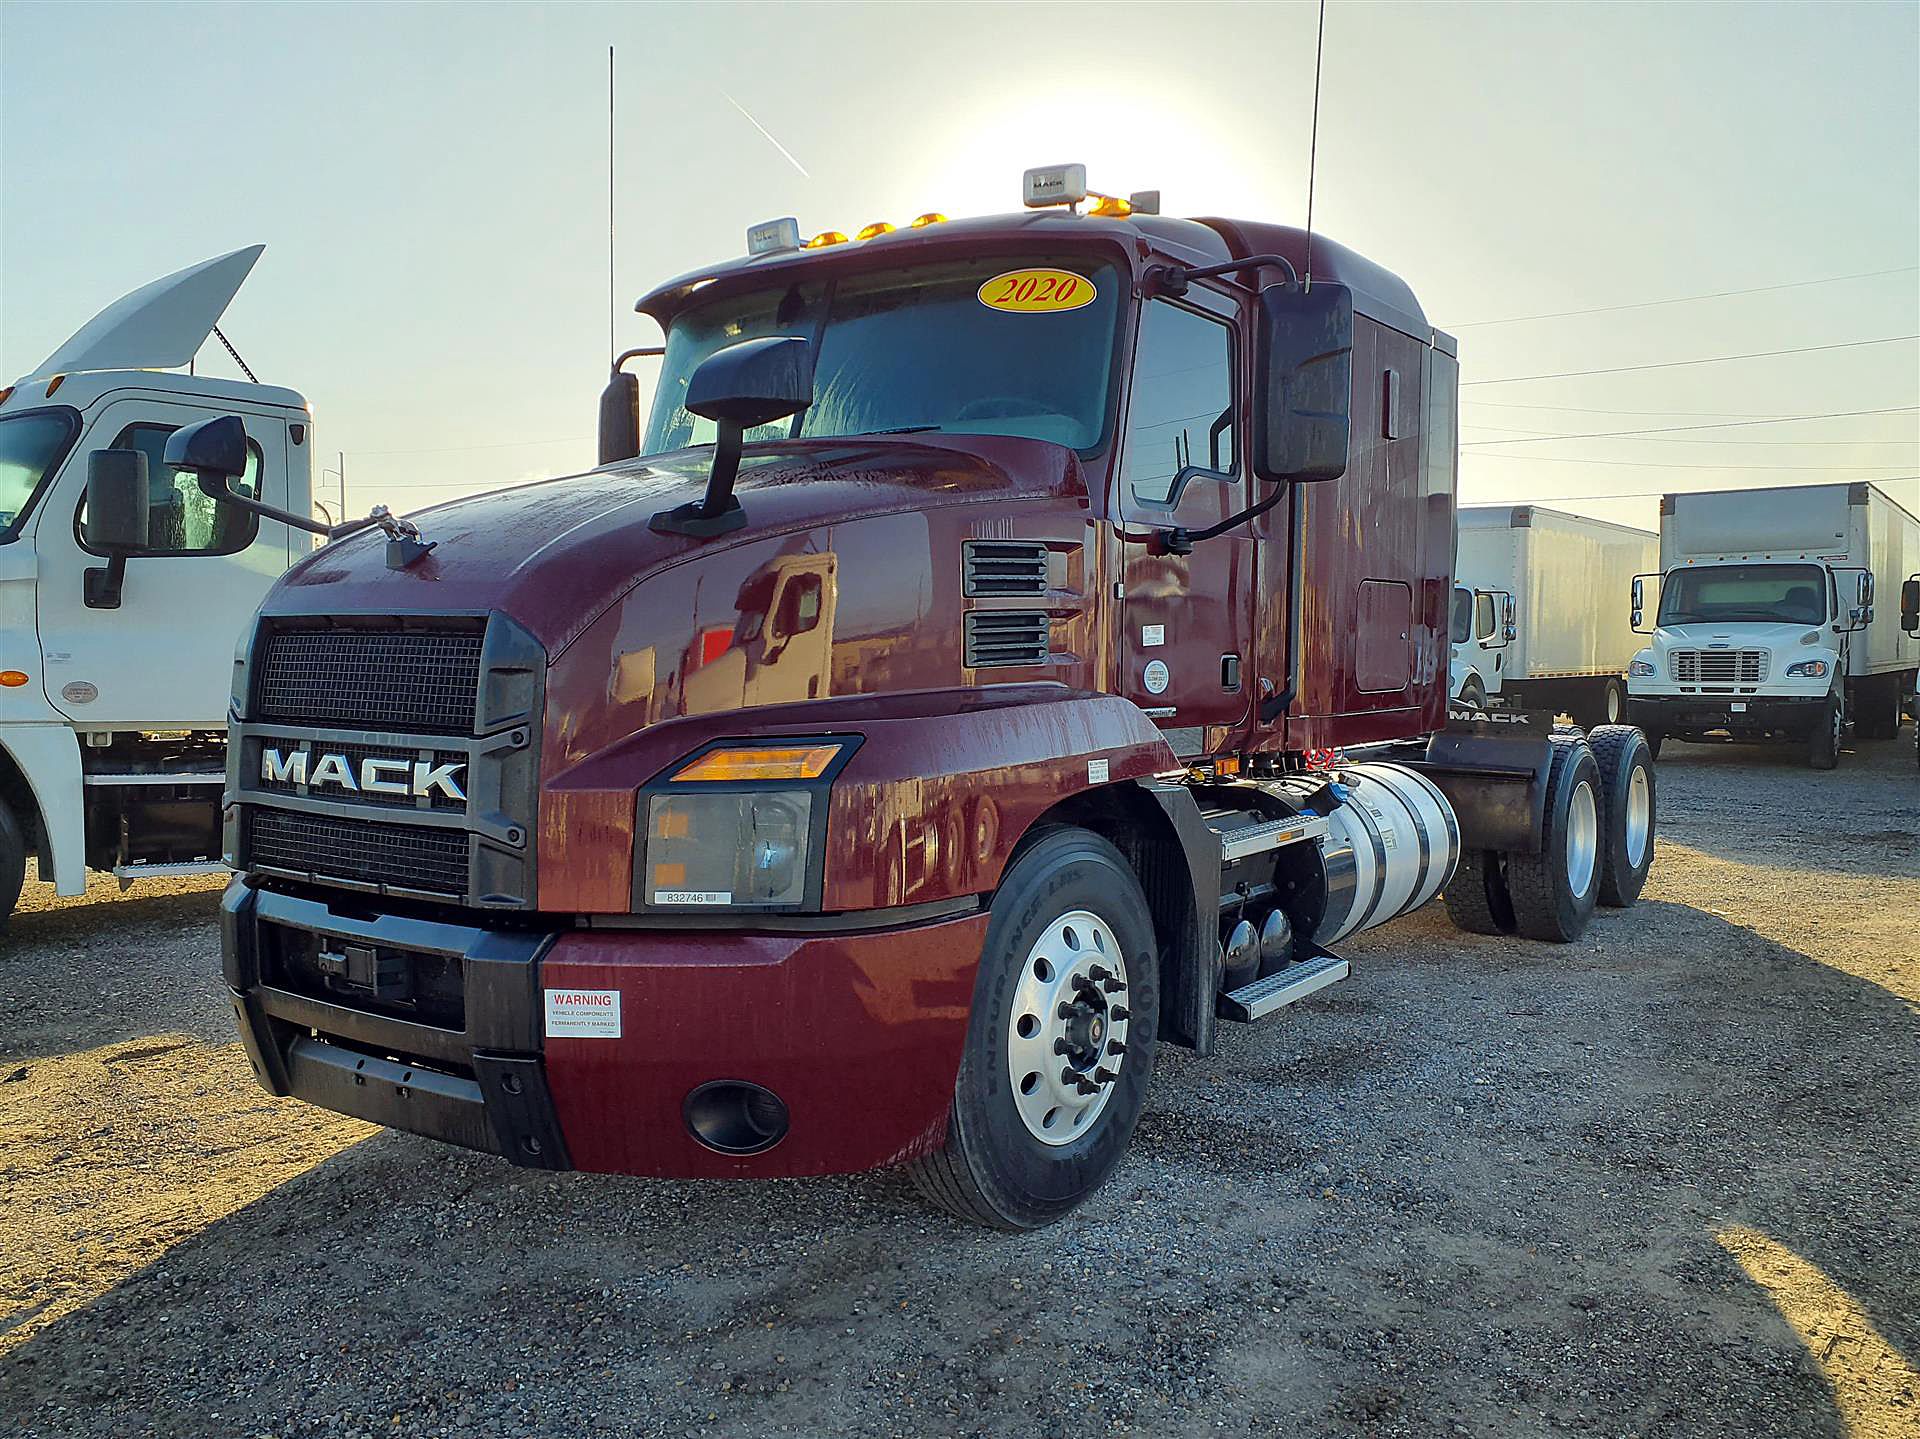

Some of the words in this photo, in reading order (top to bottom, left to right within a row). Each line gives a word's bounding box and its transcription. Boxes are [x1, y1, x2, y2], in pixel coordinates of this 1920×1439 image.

[994, 278, 1078, 302] 2020
[1449, 710, 1529, 724] MACK
[261, 748, 468, 801] MACK
[667, 893, 703, 903] 832746
[554, 994, 612, 1006] WARNING
